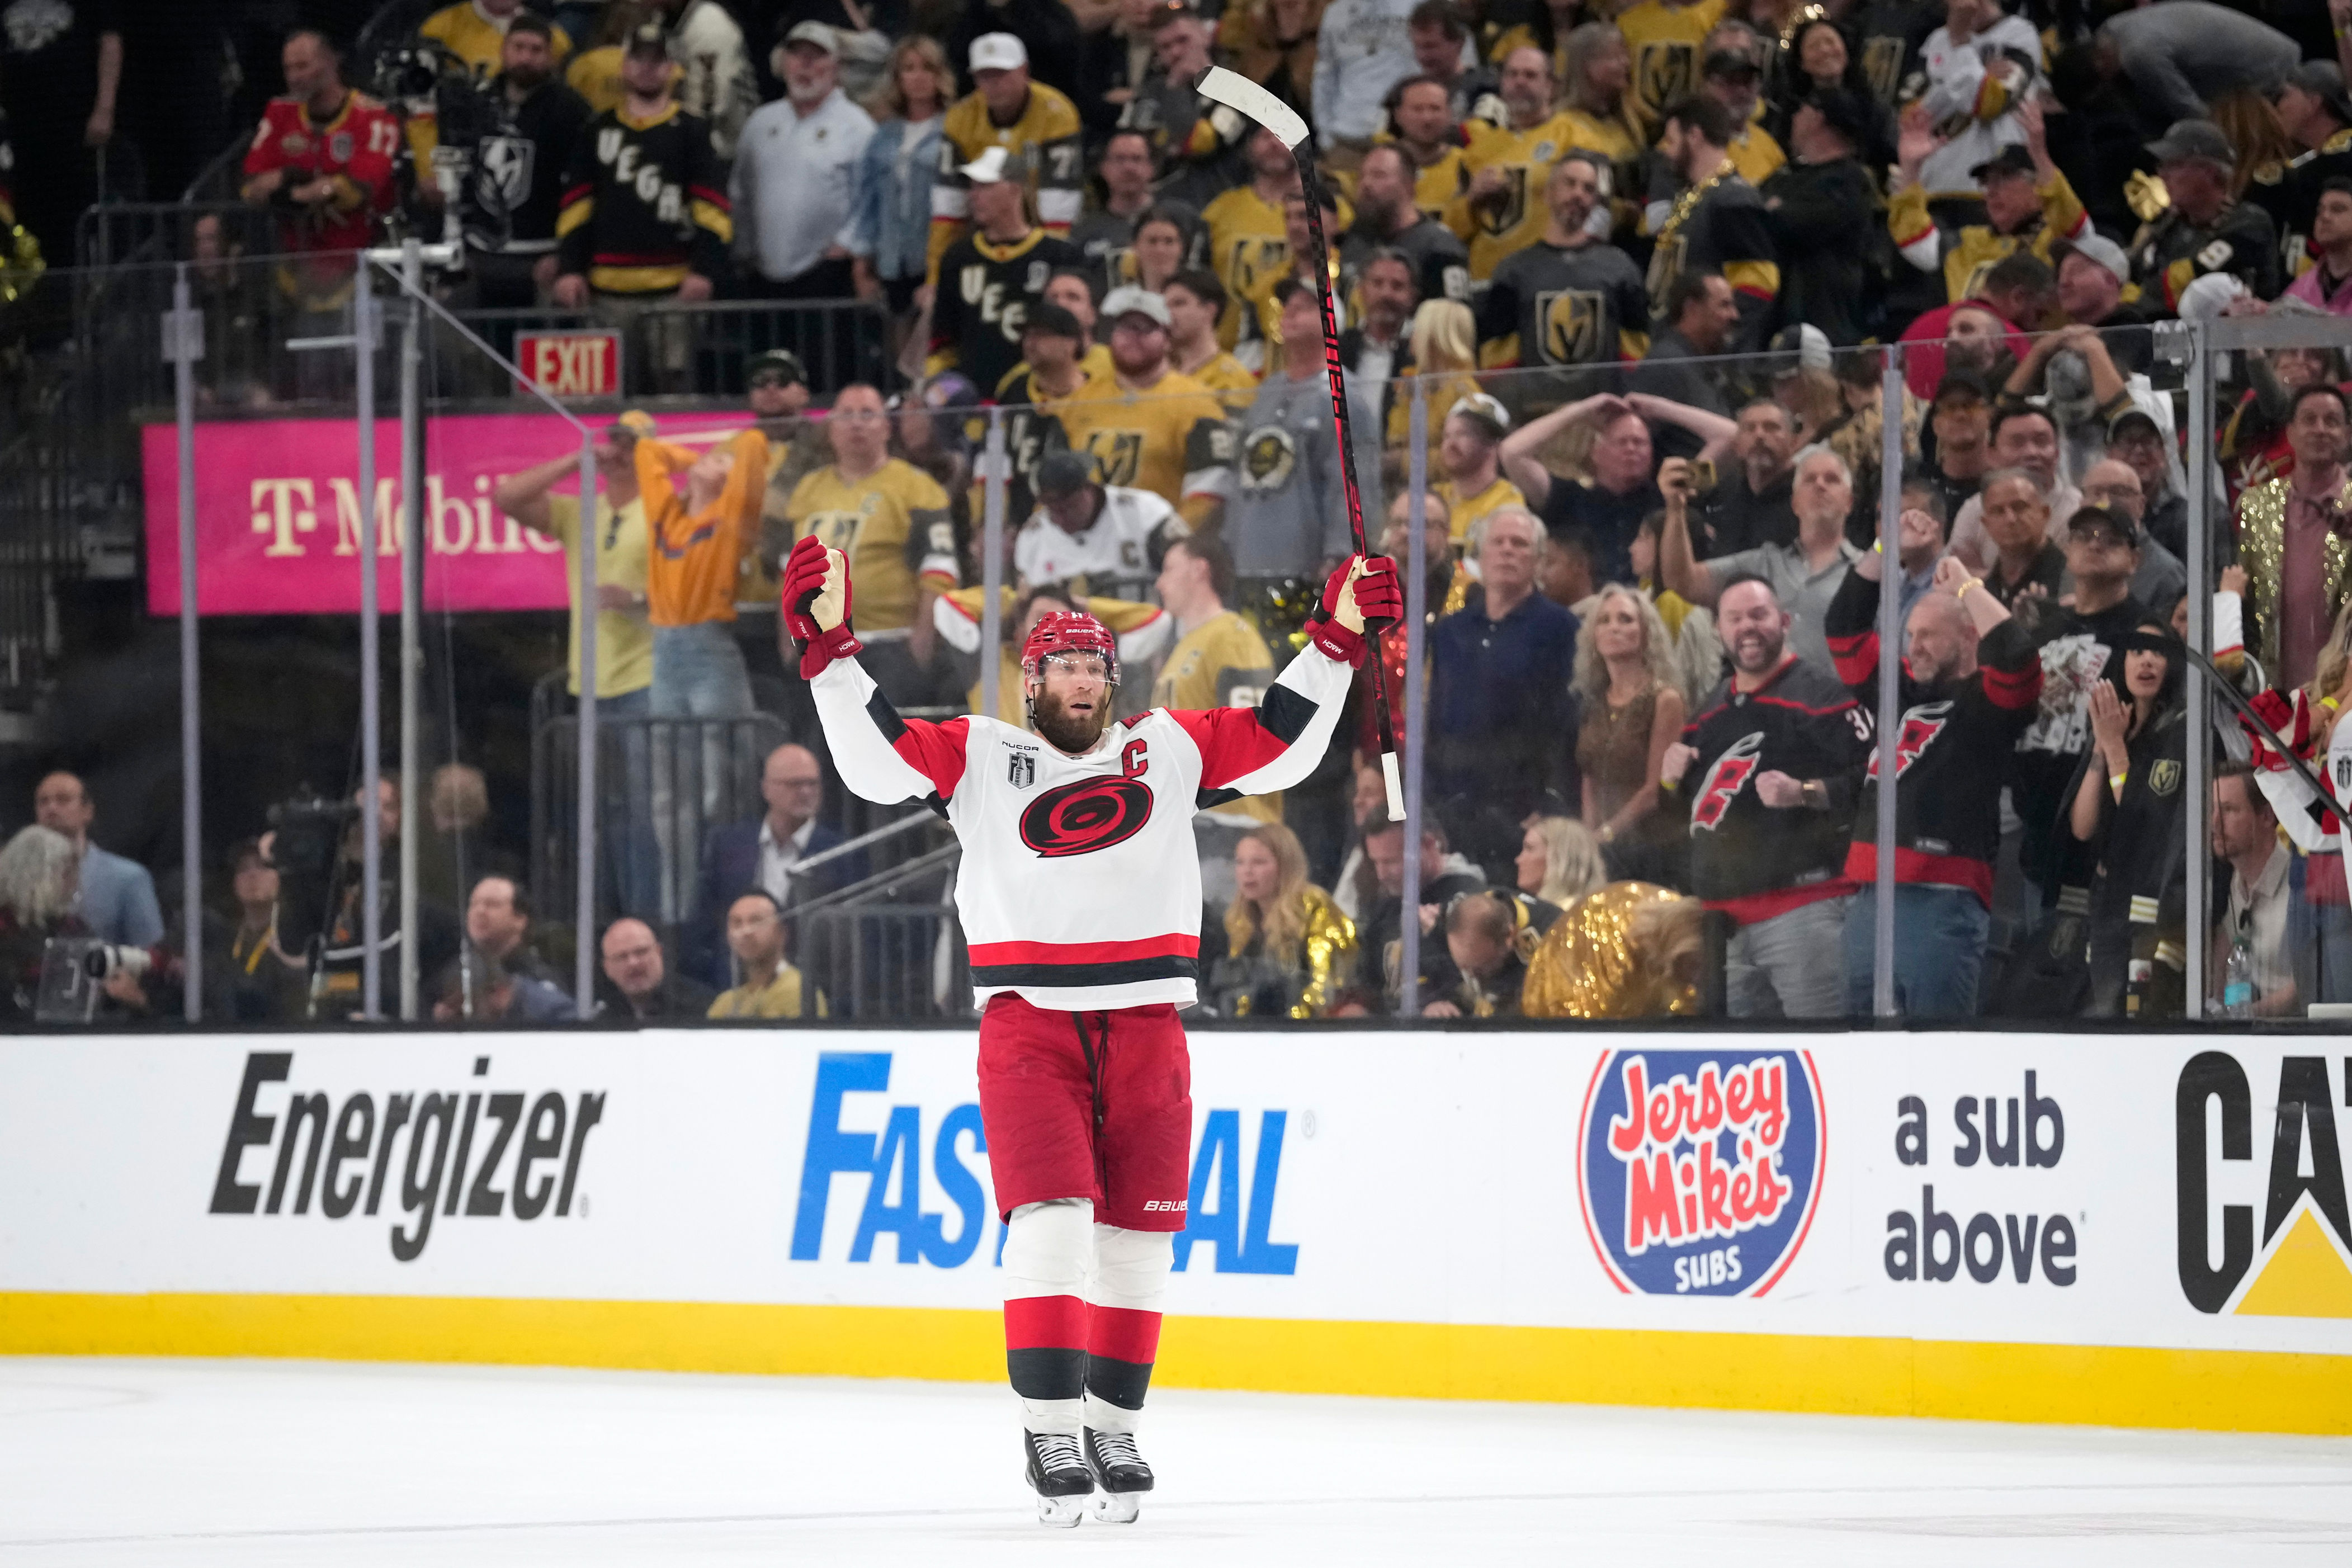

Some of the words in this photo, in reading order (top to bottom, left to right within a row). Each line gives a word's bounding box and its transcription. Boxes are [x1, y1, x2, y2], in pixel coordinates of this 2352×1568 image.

[535, 339, 610, 394] EXIT
[838, 640, 856, 653] MACH
[1322, 639, 1344, 654] MACH
[1002, 741, 1040, 752] NUCOR
[1121, 738, 1149, 777] C
[1610, 1060, 1787, 1156] Jersey
[1895, 1094, 1928, 1166] a
[1954, 1069, 2065, 1168] sub
[208, 1052, 607, 1262] Energizer
[789, 1051, 1300, 1276] FASAL
[1627, 1136, 1789, 1251] Mike's
[2176, 1050, 2352, 1314] CA
[1142, 1200, 1187, 1212] BAUE
[1884, 1183, 2076, 1287] above
[1674, 1245, 1742, 1293] SUBS
